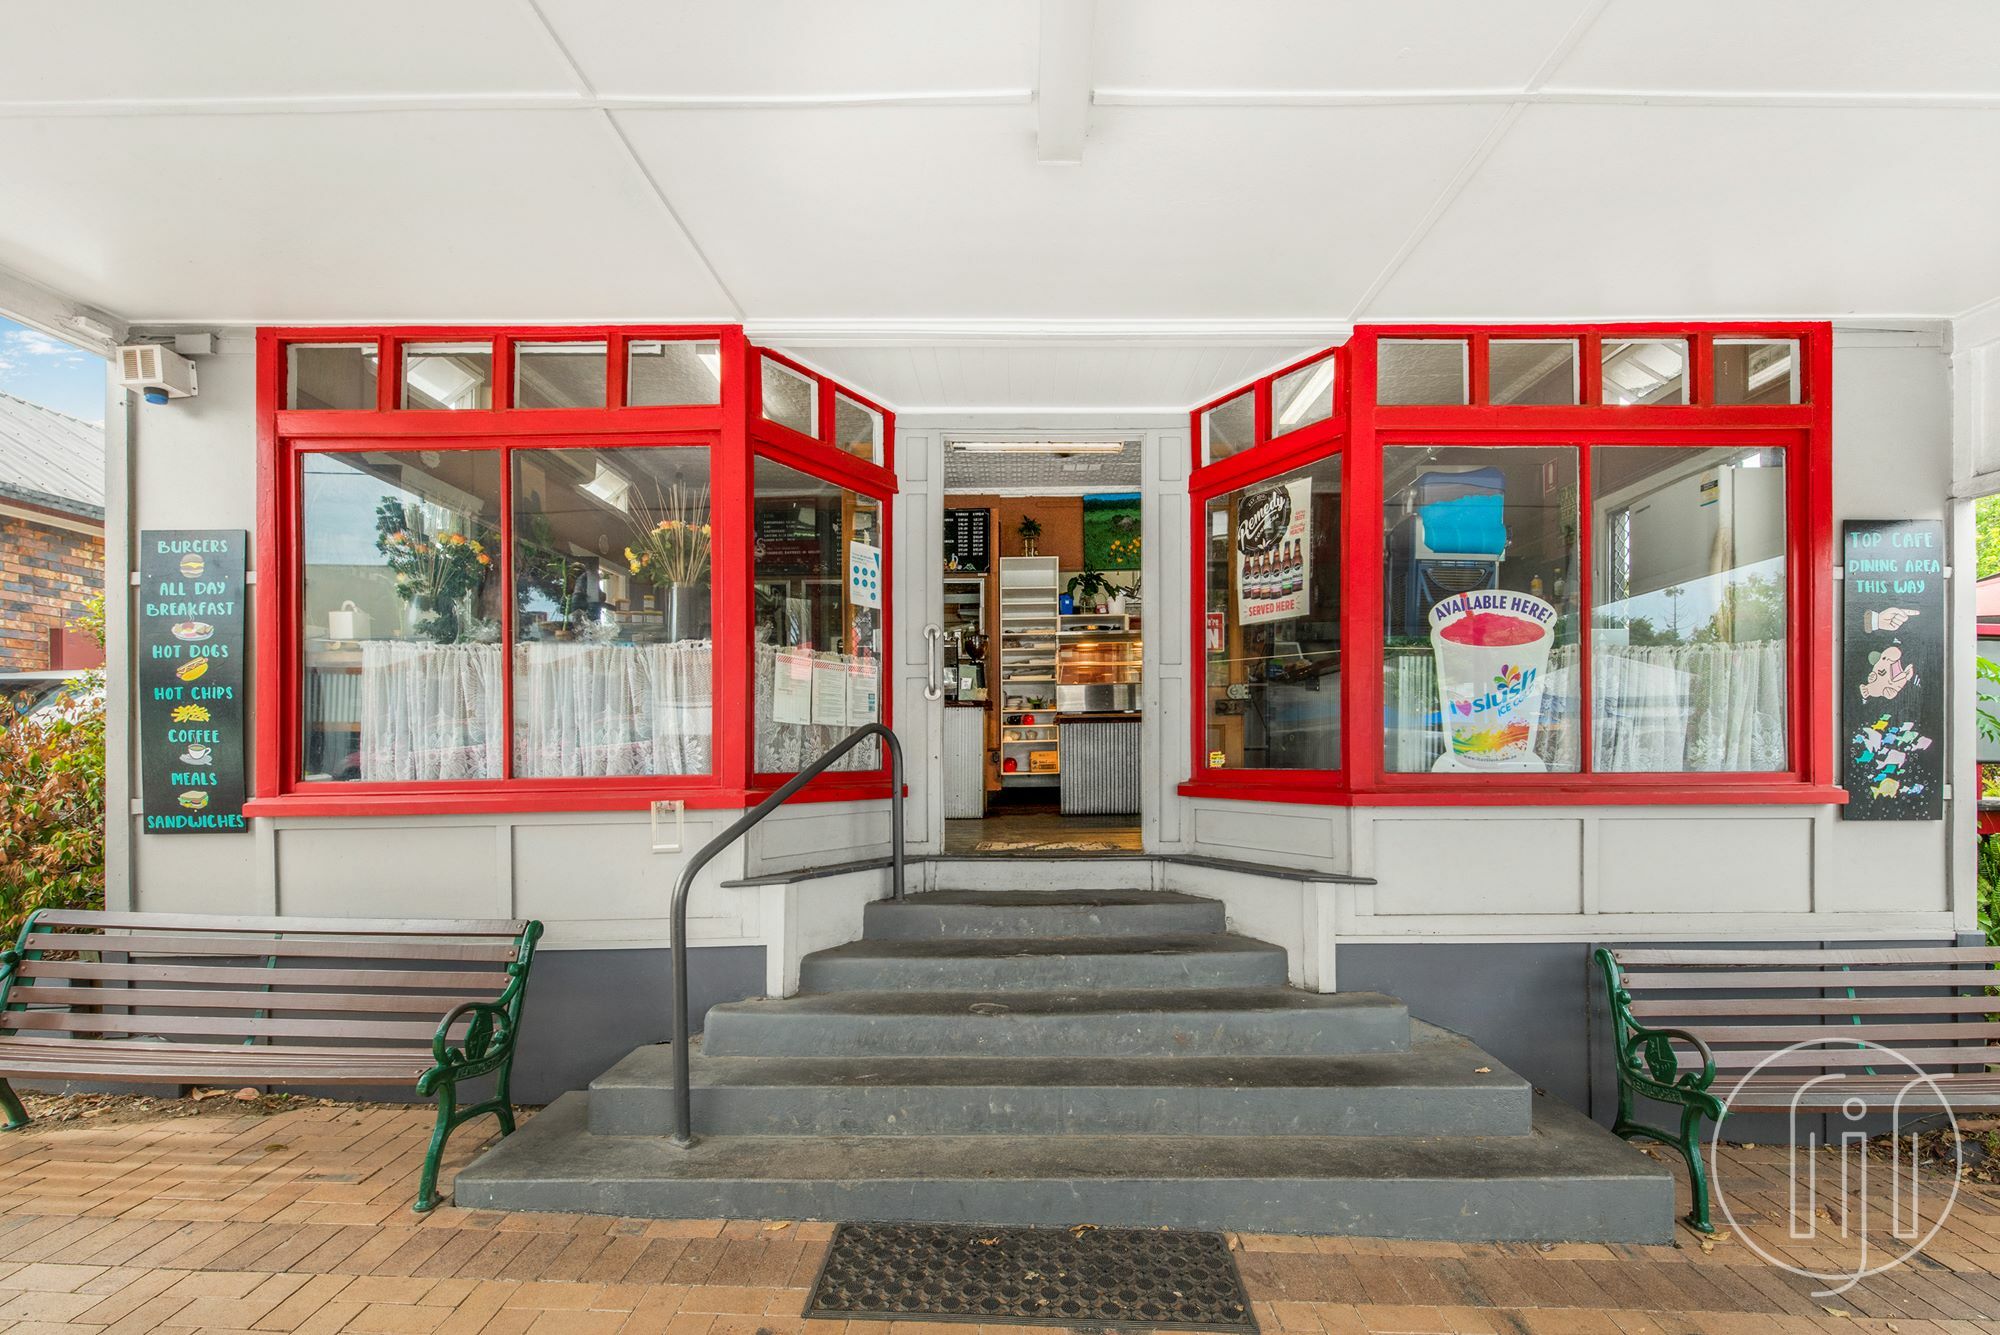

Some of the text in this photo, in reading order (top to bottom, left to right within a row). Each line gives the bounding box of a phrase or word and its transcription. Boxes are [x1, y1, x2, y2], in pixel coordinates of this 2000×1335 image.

[1237, 491, 1286, 551] Remedy
[158, 540, 228, 554] BURGERS
[1850, 532, 1934, 548] TOP CAFE
[1849, 560, 1940, 573] DINING AREA
[160, 581, 226, 596] ALL DAY
[1856, 580, 1925, 594] THIS WAY
[146, 602, 234, 617] BREAKFAST
[1248, 599, 1295, 617] SERVED HERE
[1435, 595, 1553, 624] AVAILABLE HERE!
[152, 644, 229, 659] HOT DOGS
[154, 686, 233, 701] HOT CHIPS
[1472, 668, 1536, 713] slush
[1498, 702, 1512, 717] ICE
[168, 729, 220, 743] COFFEE
[171, 772, 217, 786] MEALS
[147, 814, 244, 829] SANDWICHES
